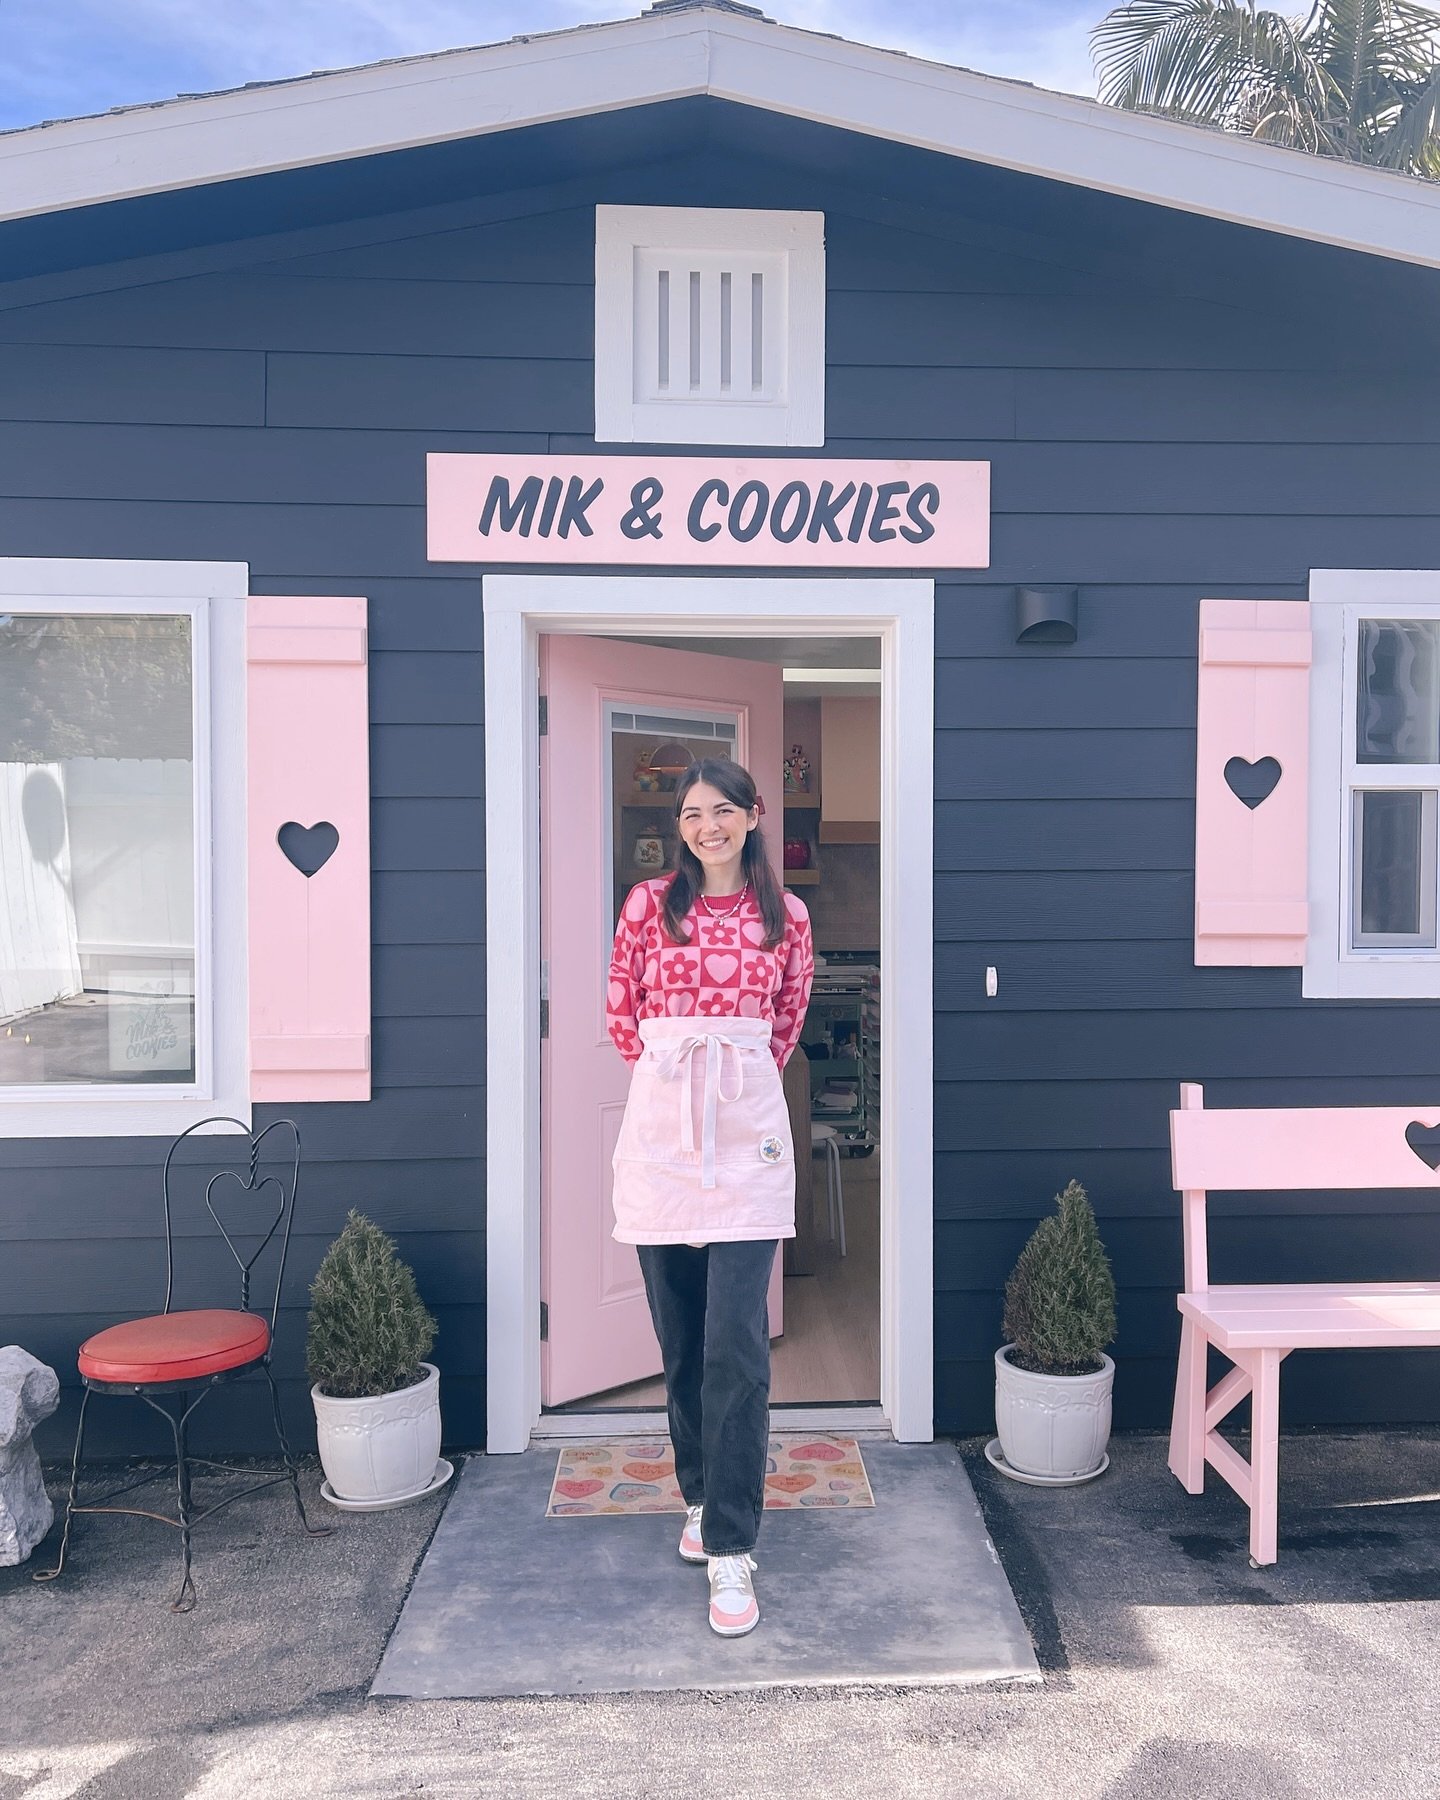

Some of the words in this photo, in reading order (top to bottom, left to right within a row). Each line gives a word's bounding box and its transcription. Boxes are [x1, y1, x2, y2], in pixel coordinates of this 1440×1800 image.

[478, 475, 604, 539] MIK
[619, 476, 664, 540] &
[687, 478, 941, 544] COOKIES
[126, 1035, 179, 1060] COOKIES
